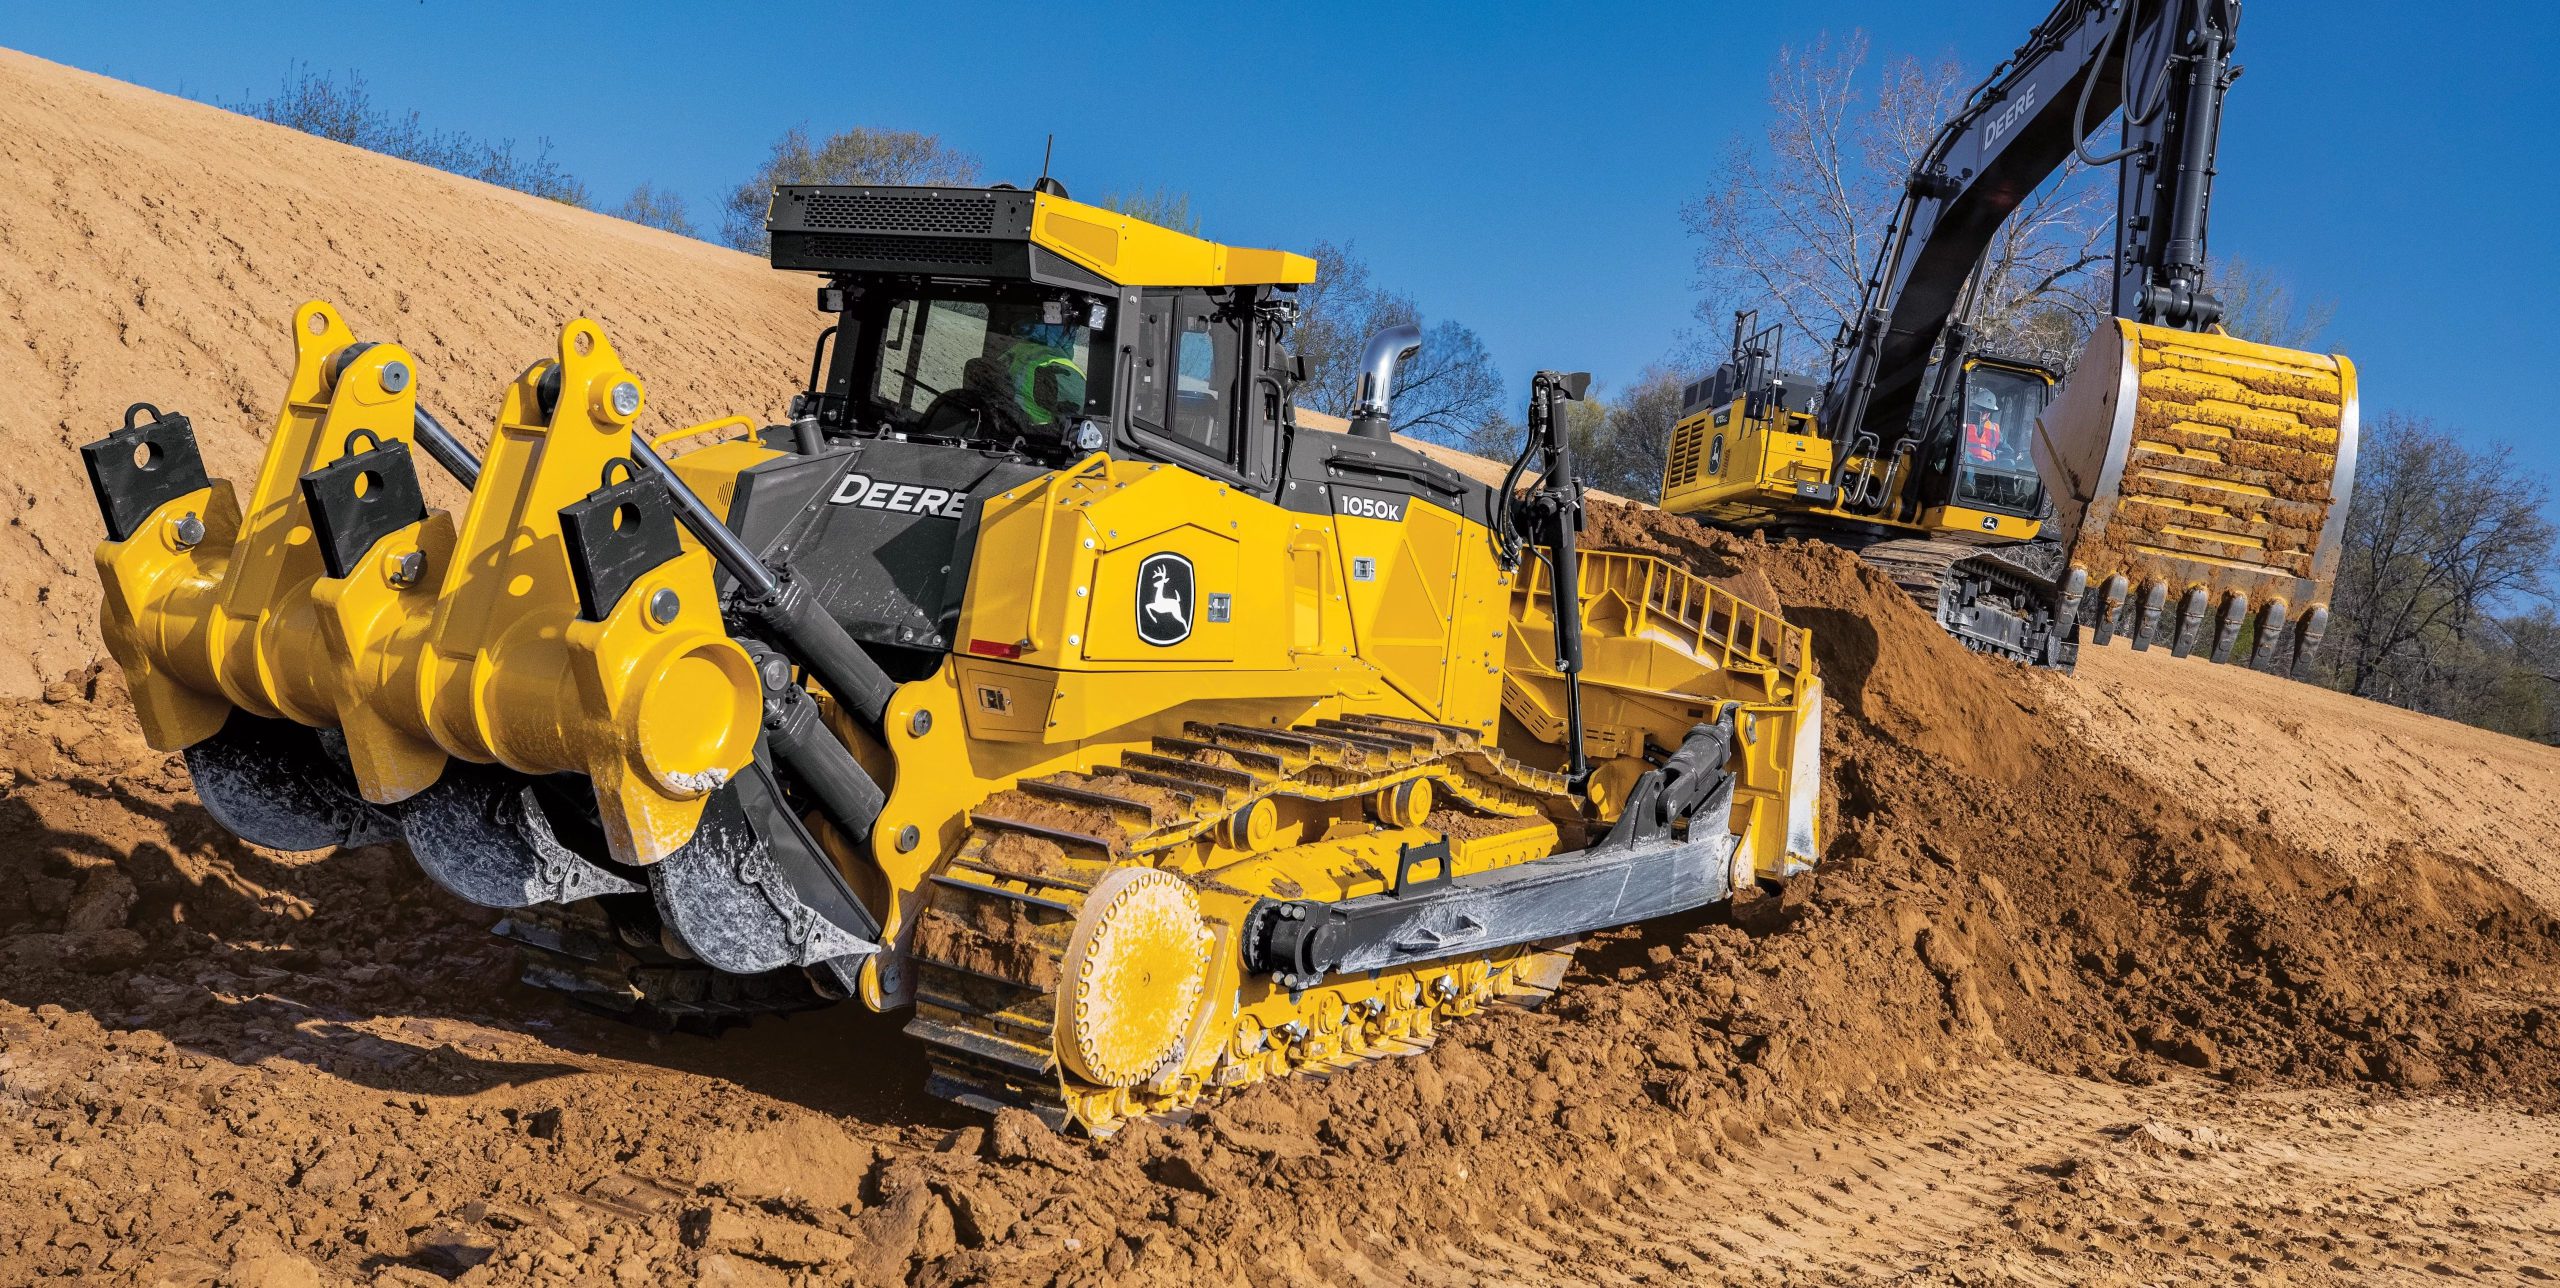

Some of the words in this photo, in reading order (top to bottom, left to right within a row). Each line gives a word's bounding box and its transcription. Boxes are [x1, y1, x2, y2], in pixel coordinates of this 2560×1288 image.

[1984, 82, 2037, 152] DEERE
[829, 473, 969, 519] DEERE
[1342, 495, 1400, 521] 1050K
